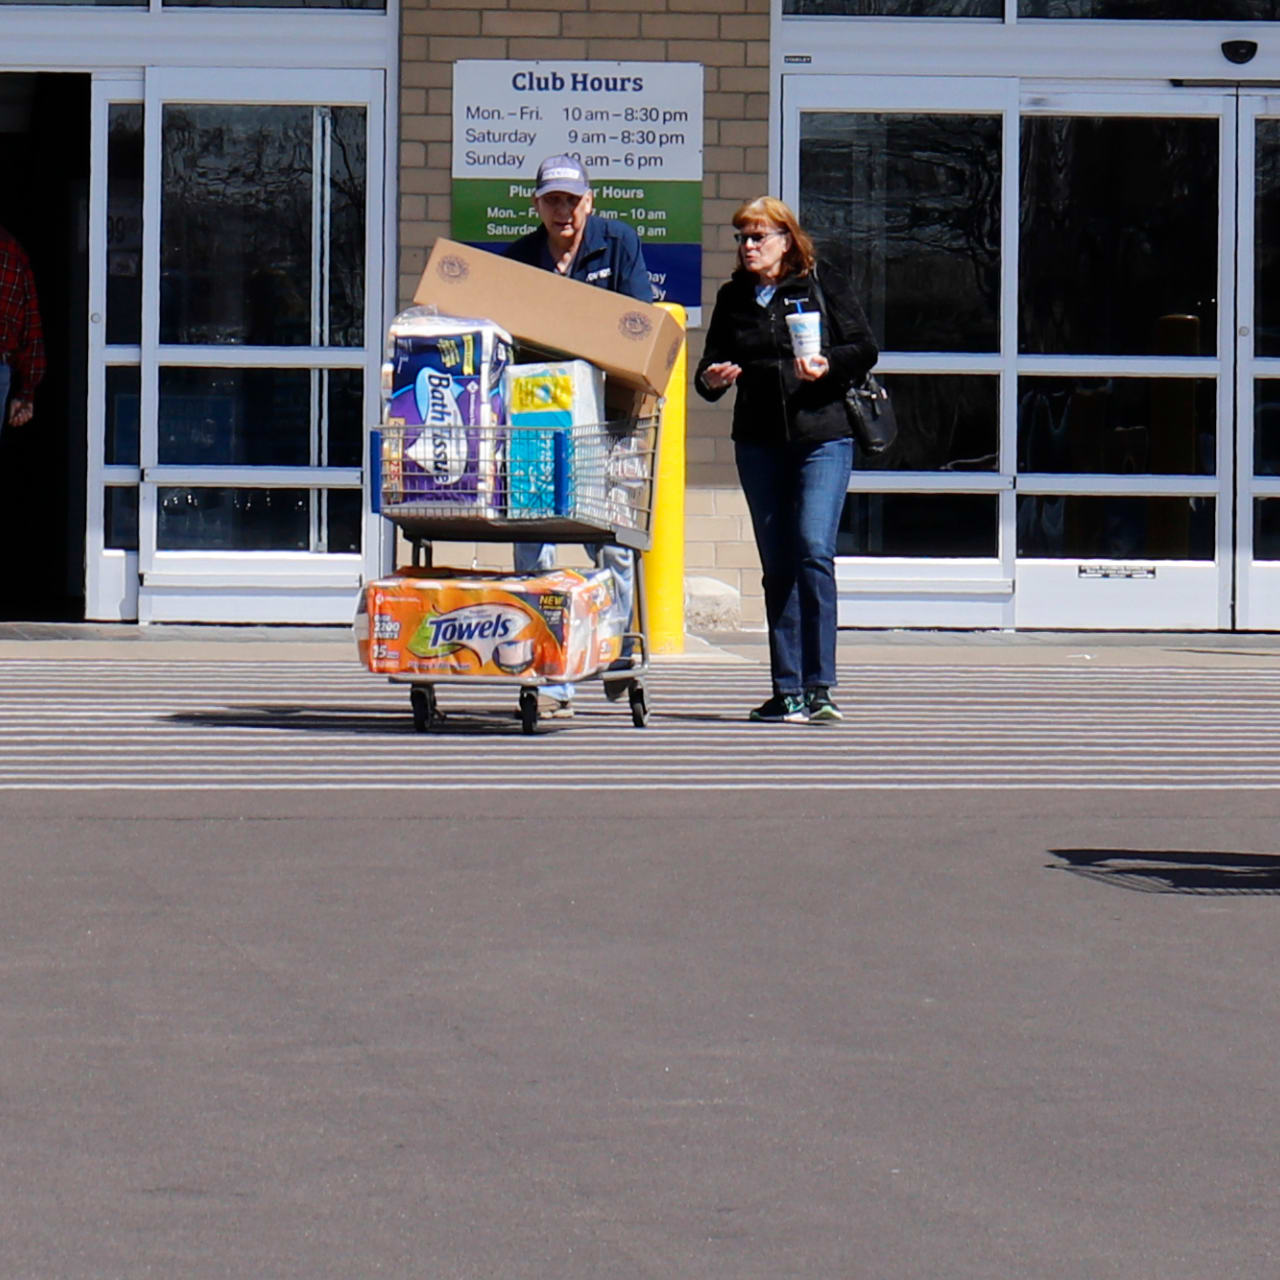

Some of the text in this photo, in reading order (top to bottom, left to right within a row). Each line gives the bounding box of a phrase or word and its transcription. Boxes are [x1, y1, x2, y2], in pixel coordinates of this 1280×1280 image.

[511, 71, 644, 92] Club Hours
[466, 105, 505, 120] Mon.
[520, 106, 544, 121] Fri.
[563, 107, 582, 121] 10
[585, 110, 609, 121] am
[624, 107, 659, 122] 8:30
[662, 111, 688, 125] pm
[465, 128, 537, 146] Saturday
[568, 129, 578, 144] 9
[581, 132, 606, 144] am
[621, 130, 656, 144] 8:30
[659, 133, 685, 148] pm
[465, 150, 526, 169] Sunday
[585, 155, 609, 167] am
[624, 152, 635, 167] 6
[638, 155, 663, 170] pm
[602, 185, 645, 199] Hours
[487, 206, 517, 218] Mon.
[631, 208, 646, 220] 10
[647, 210, 667, 220] am
[637, 225, 667, 237] 9 am
[428, 374, 452, 422] Bath
[539, 595, 564, 605] NEW
[428, 614, 513, 648] Towels
